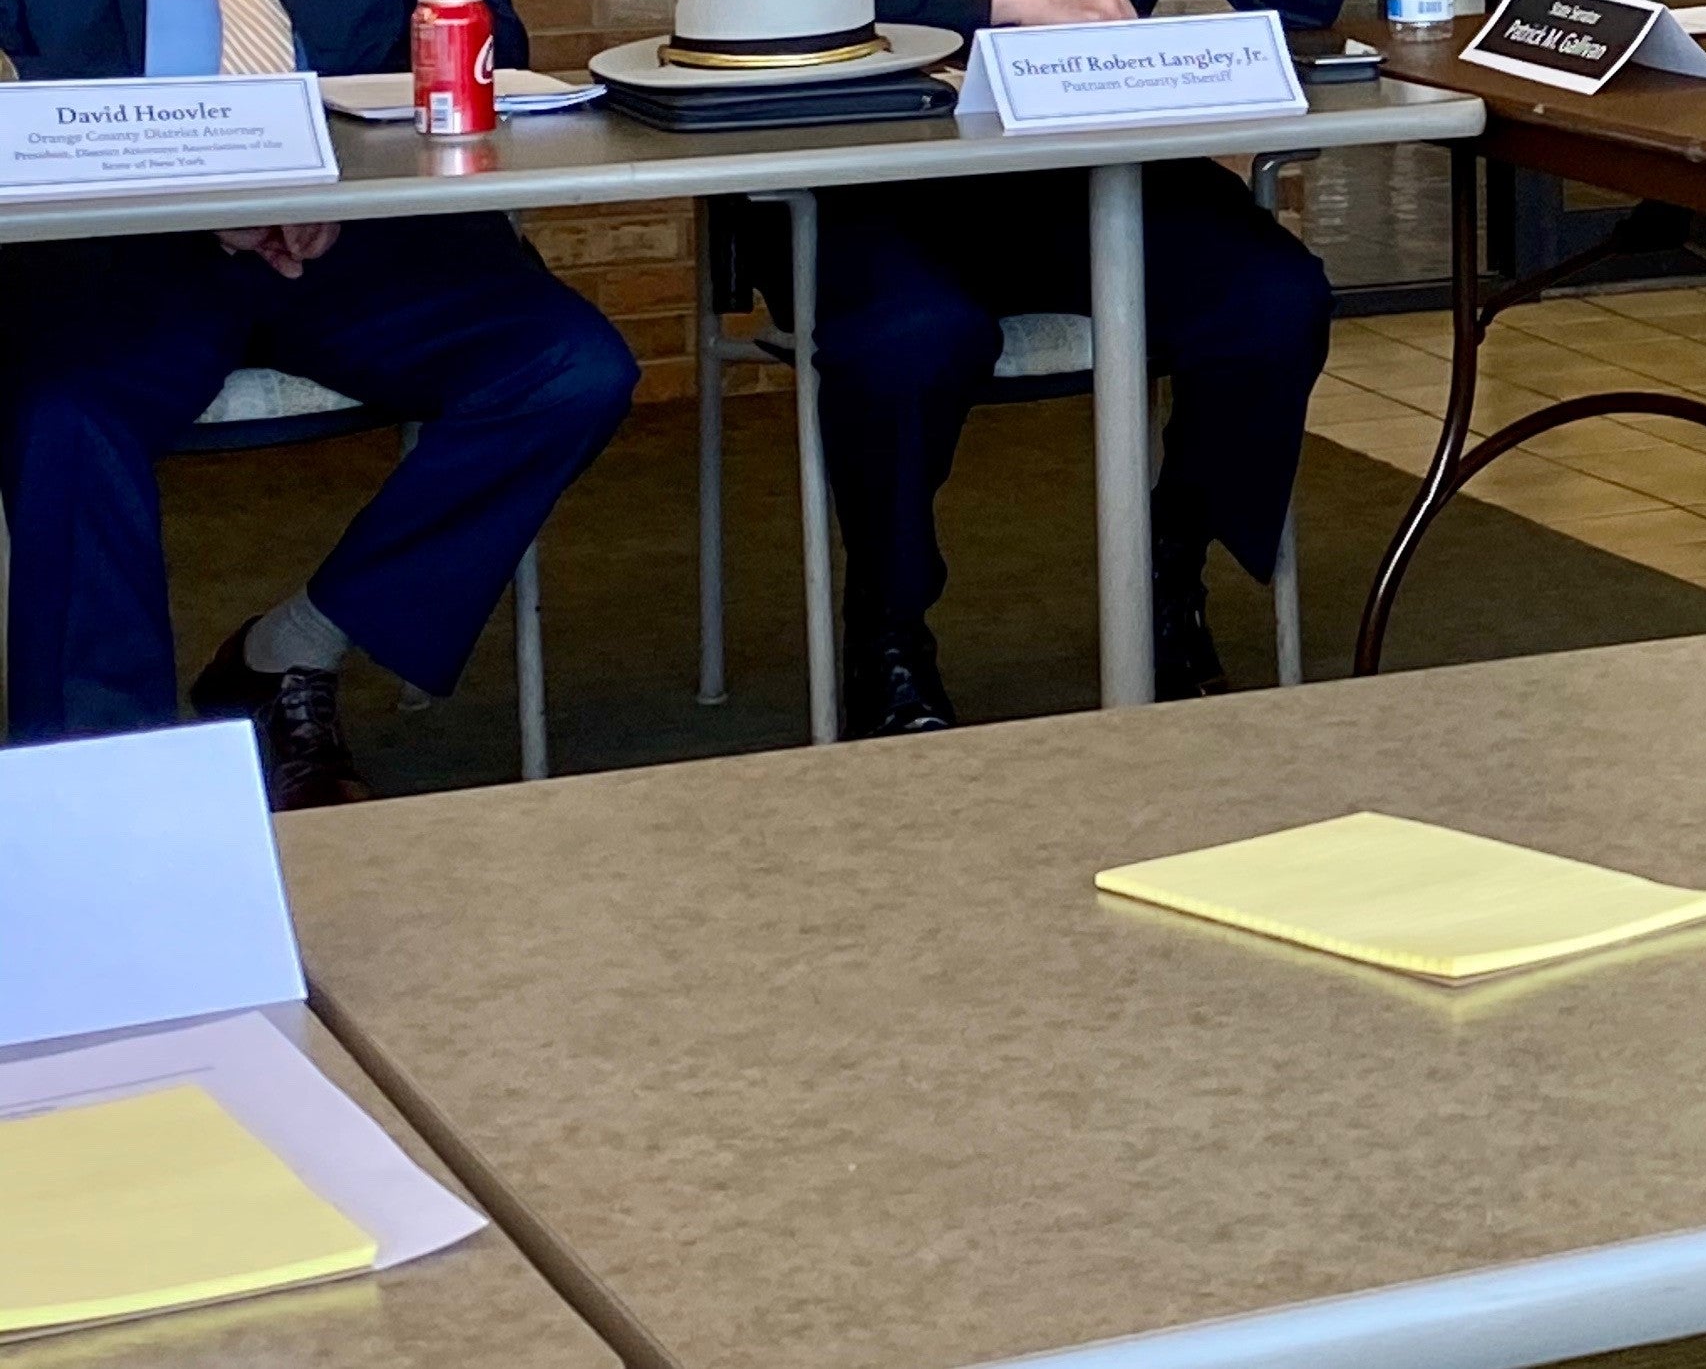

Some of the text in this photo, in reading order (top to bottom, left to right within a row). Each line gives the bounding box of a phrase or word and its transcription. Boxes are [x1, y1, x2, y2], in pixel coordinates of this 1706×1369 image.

[1503, 19, 1549, 46] Patrick
[1012, 55, 1082, 76] Sheriff
[1086, 54, 1155, 72] Robert
[1061, 69, 1232, 93] Putnam County Sheriff
[55, 102, 232, 125] David Hoovler
[28, 126, 265, 145] Orange County District Attorney
